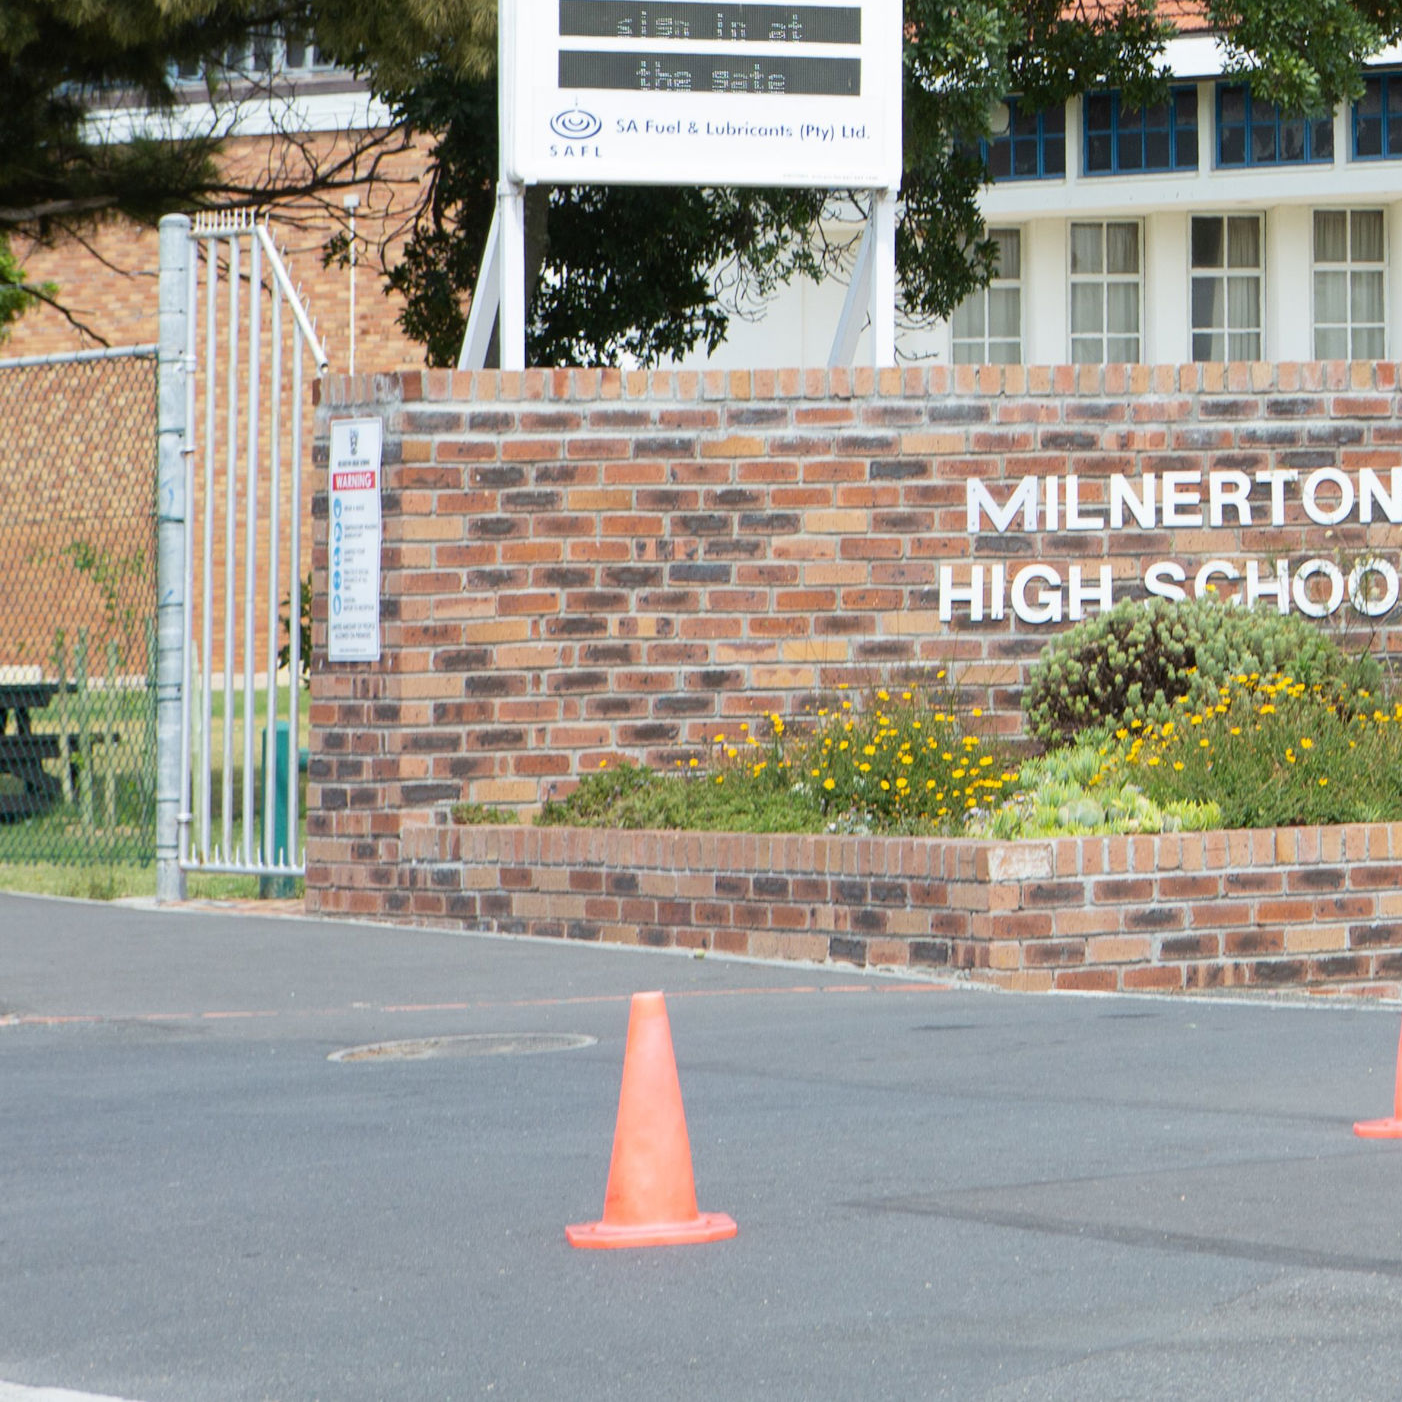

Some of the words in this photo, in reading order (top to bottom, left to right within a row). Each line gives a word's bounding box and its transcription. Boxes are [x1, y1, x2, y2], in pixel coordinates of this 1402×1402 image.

[617, 9, 690, 40] sign
[716, 12, 747, 41] in
[768, 13, 804, 43] at
[635, 59, 692, 92] the
[711, 62, 786, 94] gate
[615, 118, 638, 134] SA
[645, 120, 681, 135] Fuel
[687, 121, 699, 135] &
[706, 121, 793, 138] Lubricants
[799, 123, 836, 143] (Pty)
[842, 124, 871, 141] Ltd.
[335, 472, 372, 489] WARNING
[938, 563, 1113, 624] HIGH
